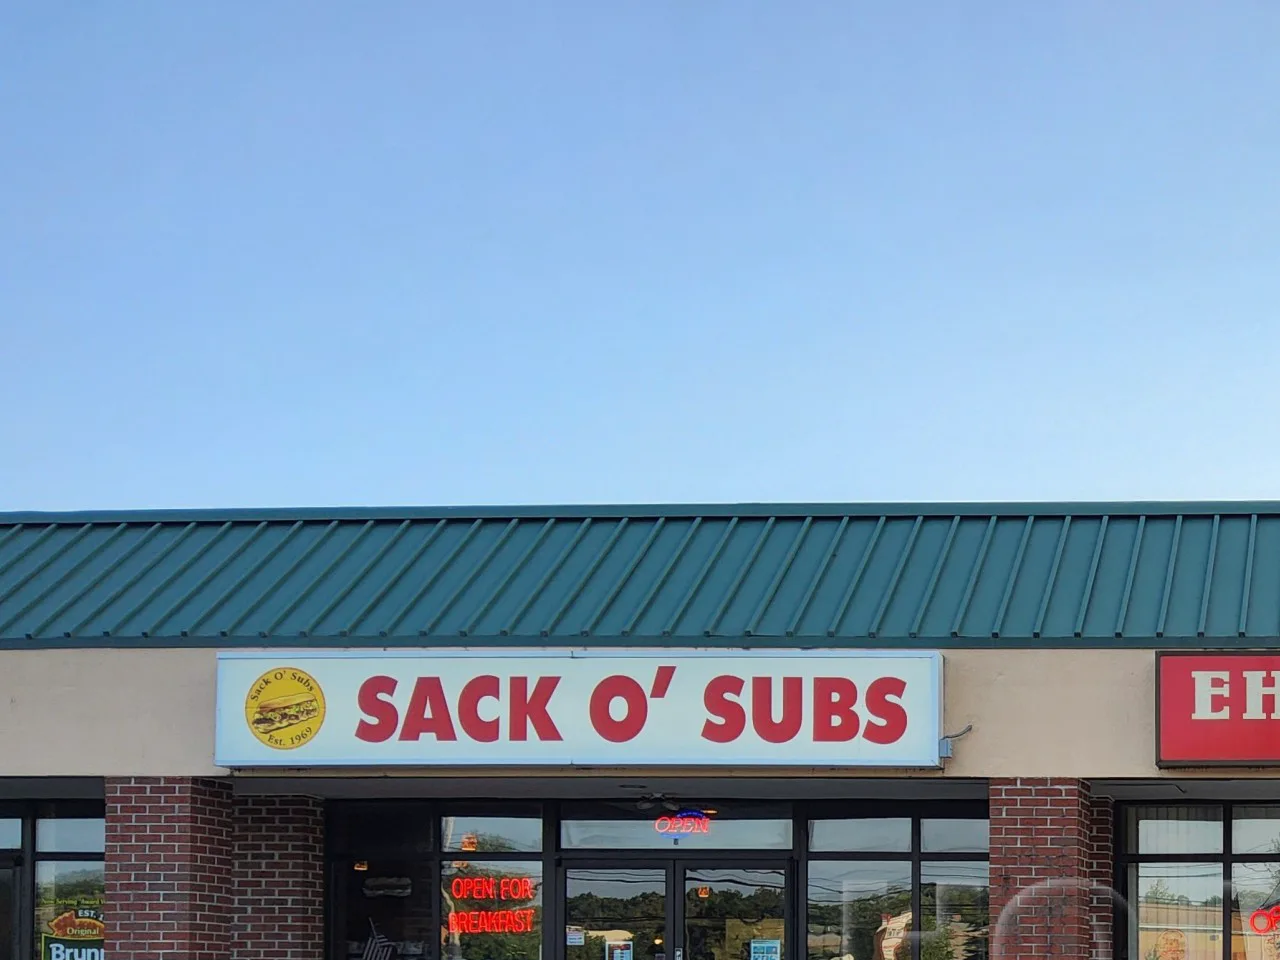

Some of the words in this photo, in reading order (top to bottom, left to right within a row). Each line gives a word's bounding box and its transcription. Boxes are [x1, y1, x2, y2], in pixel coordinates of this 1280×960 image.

[250, 678, 272, 701] Sack
[290, 672, 314, 692] Subs
[355, 675, 563, 743] SACK
[701, 675, 908, 745] SUBS
[267, 734, 286, 746] Est.
[290, 726, 313, 745] 1969
[655, 816, 710, 834] OPEN
[451, 877, 496, 899] OPEN
[500, 877, 534, 900] FOR
[66, 926, 100, 937] Original
[448, 909, 535, 934] BREAKFAST
